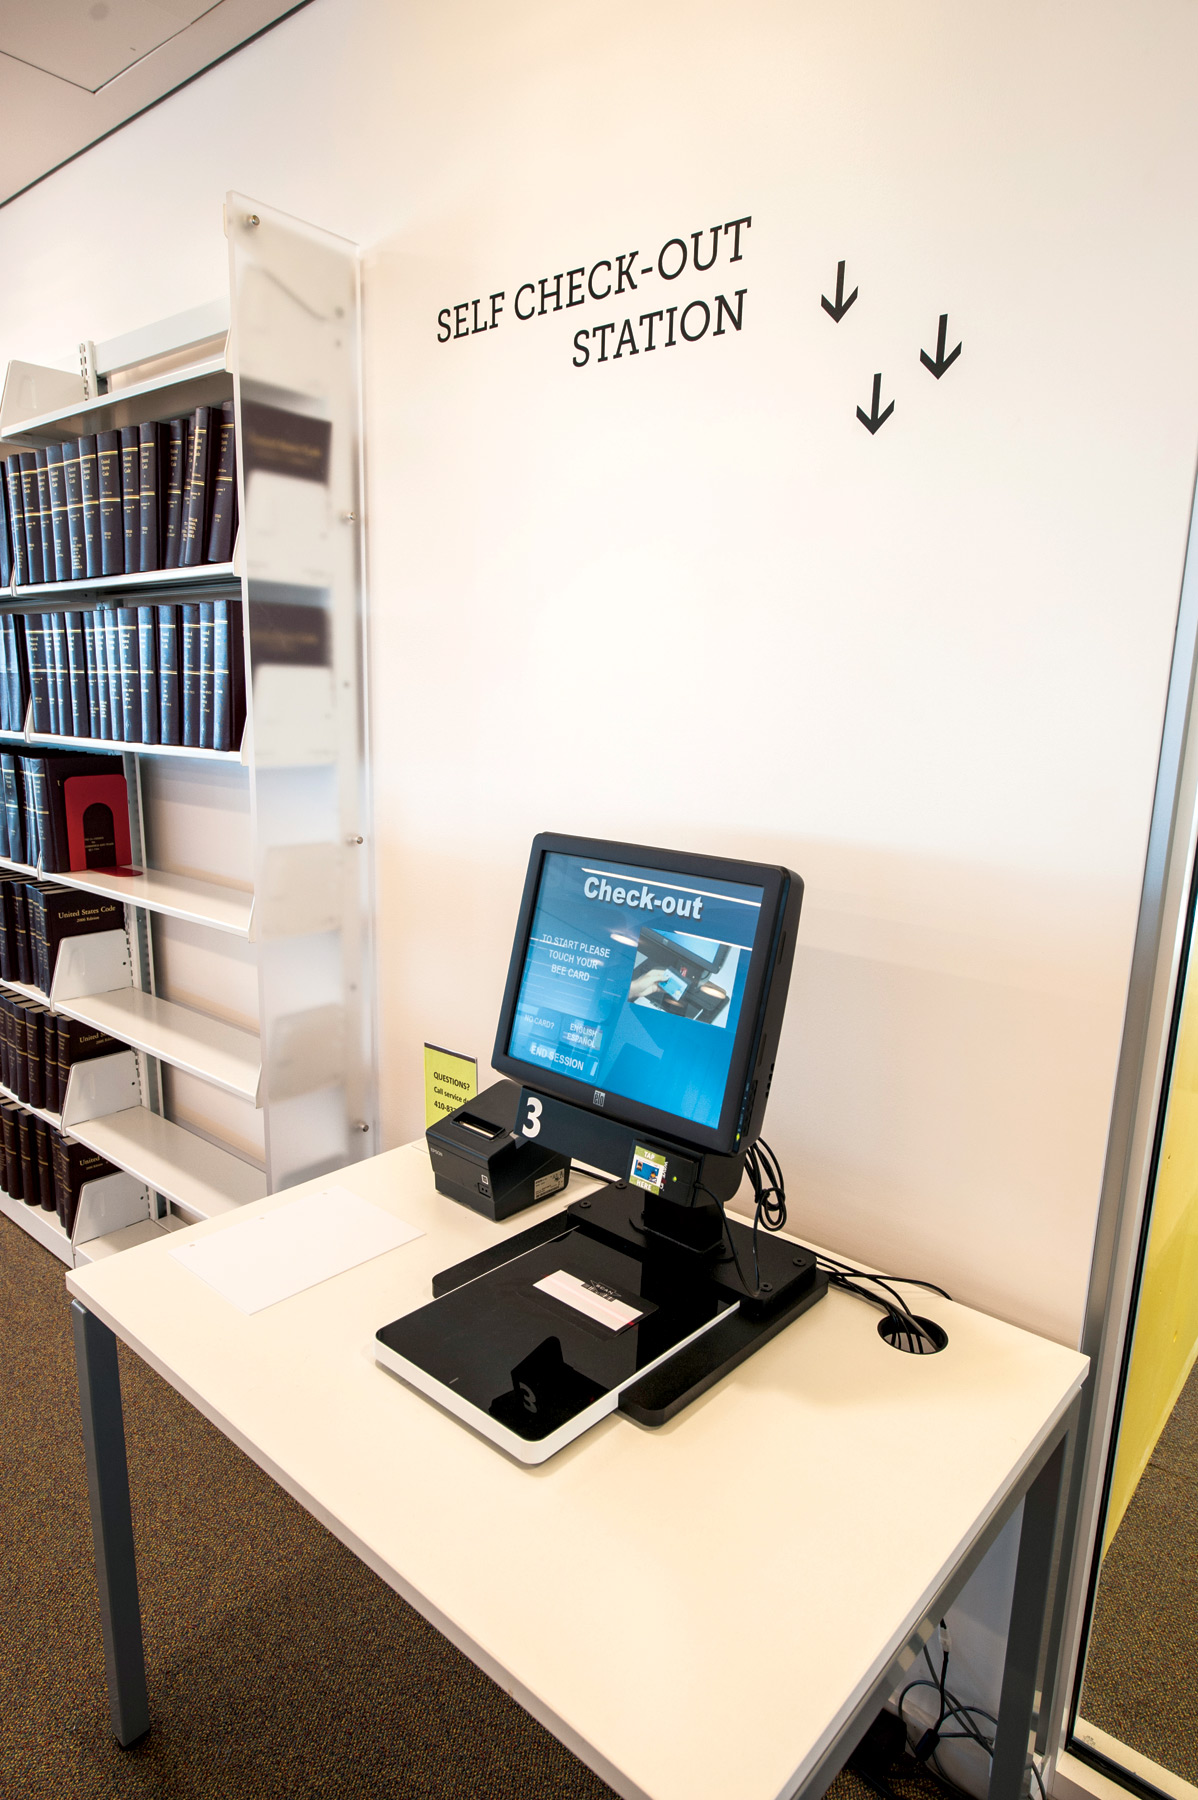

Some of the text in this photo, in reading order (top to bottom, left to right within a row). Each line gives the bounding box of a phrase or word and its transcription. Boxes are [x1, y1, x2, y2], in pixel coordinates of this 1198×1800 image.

[437, 215, 752, 343] SELF CHECK-OUT
[572, 288, 748, 368] STATION
[584, 877, 703, 919] Check-out
[58, 910, 80, 919] United
[542, 934, 611, 958] TO START PLEASE
[549, 949, 598, 970] TOUCH YOUR
[551, 964, 590, 981] BEE CARD
[534, 1018, 555, 1030] CARD?
[570, 1023, 598, 1038] ENGLISH
[79, 1032, 99, 1043] United
[530, 1044, 585, 1071] END SESSION
[433, 1071, 470, 1091] QUESTIONS?
[433, 1086, 444, 1095] Call
[444, 1090, 462, 1102] service
[521, 1096, 543, 1138] 3
[644, 1151, 656, 1160] TAP
[636, 1180, 652, 1191] HERE
